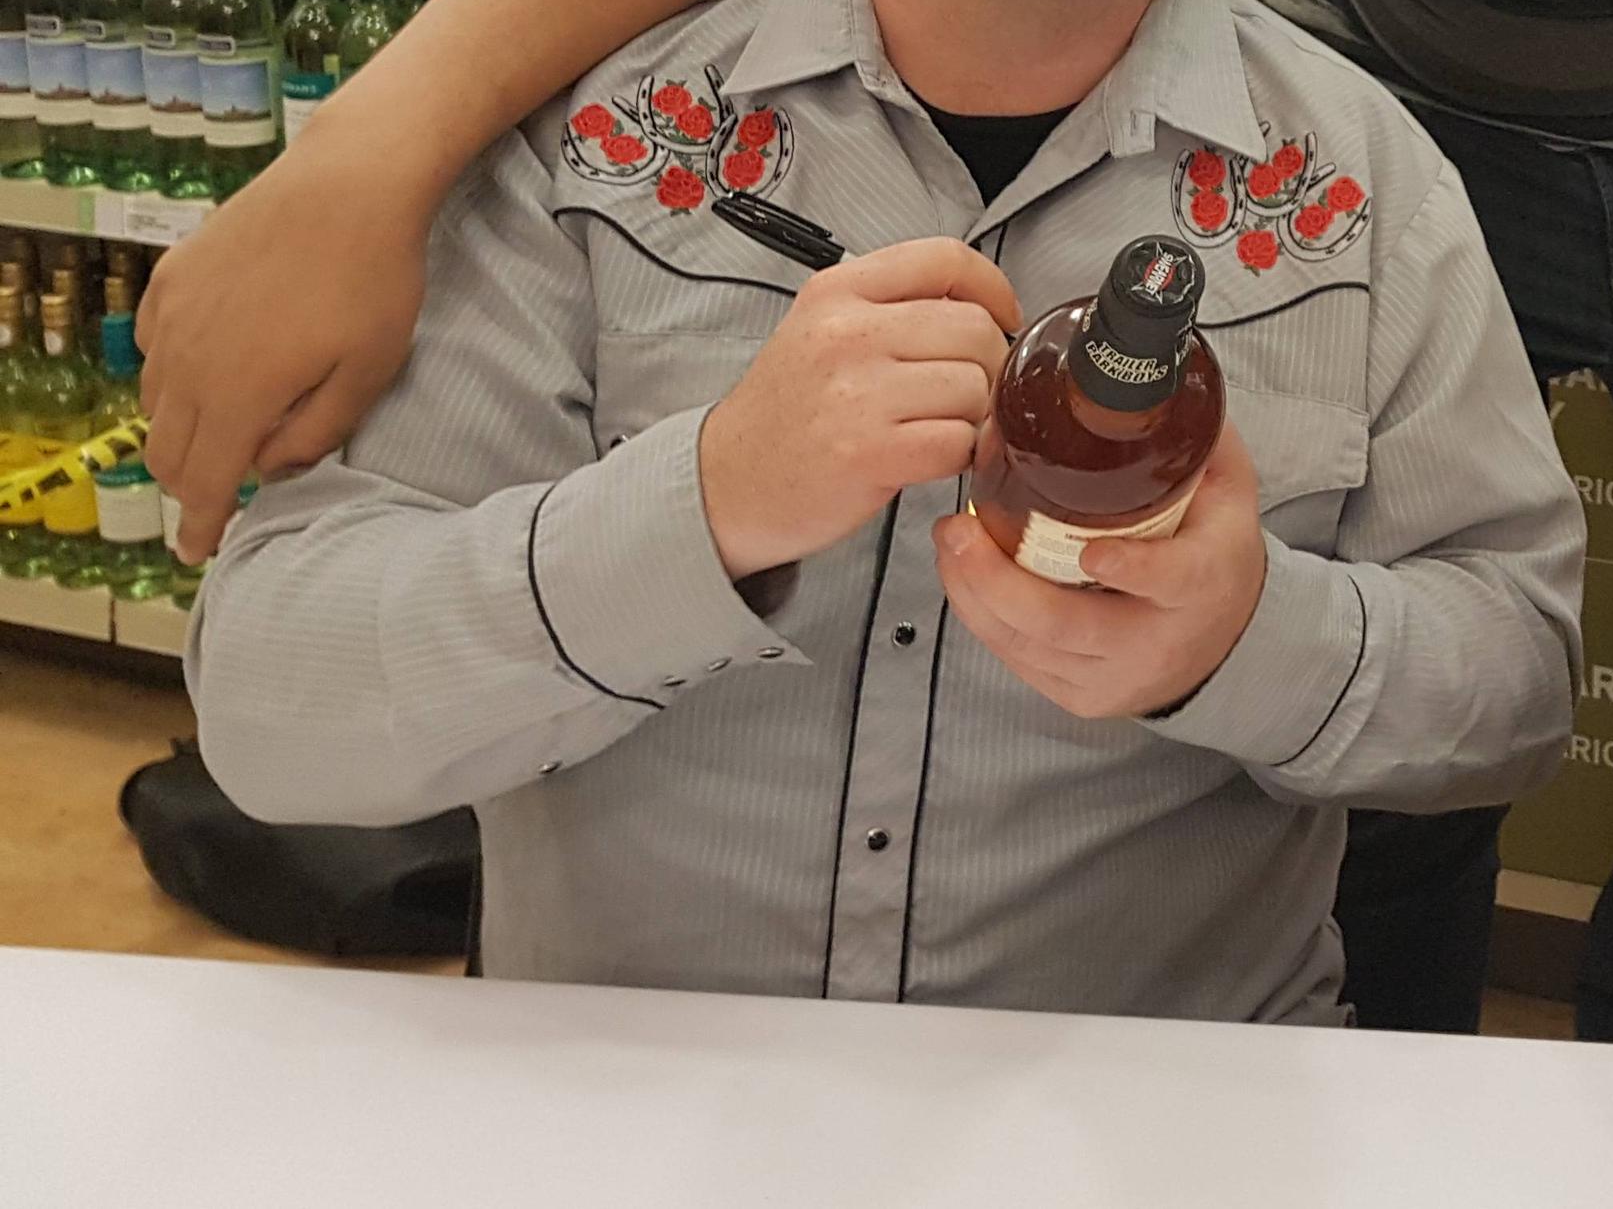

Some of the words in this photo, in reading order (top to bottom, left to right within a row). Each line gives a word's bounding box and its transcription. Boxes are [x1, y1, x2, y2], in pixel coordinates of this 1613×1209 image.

[1086, 341, 1121, 379] PARK
[1118, 364, 1168, 385] BOYS
[1100, 341, 1157, 372] TRAILER
